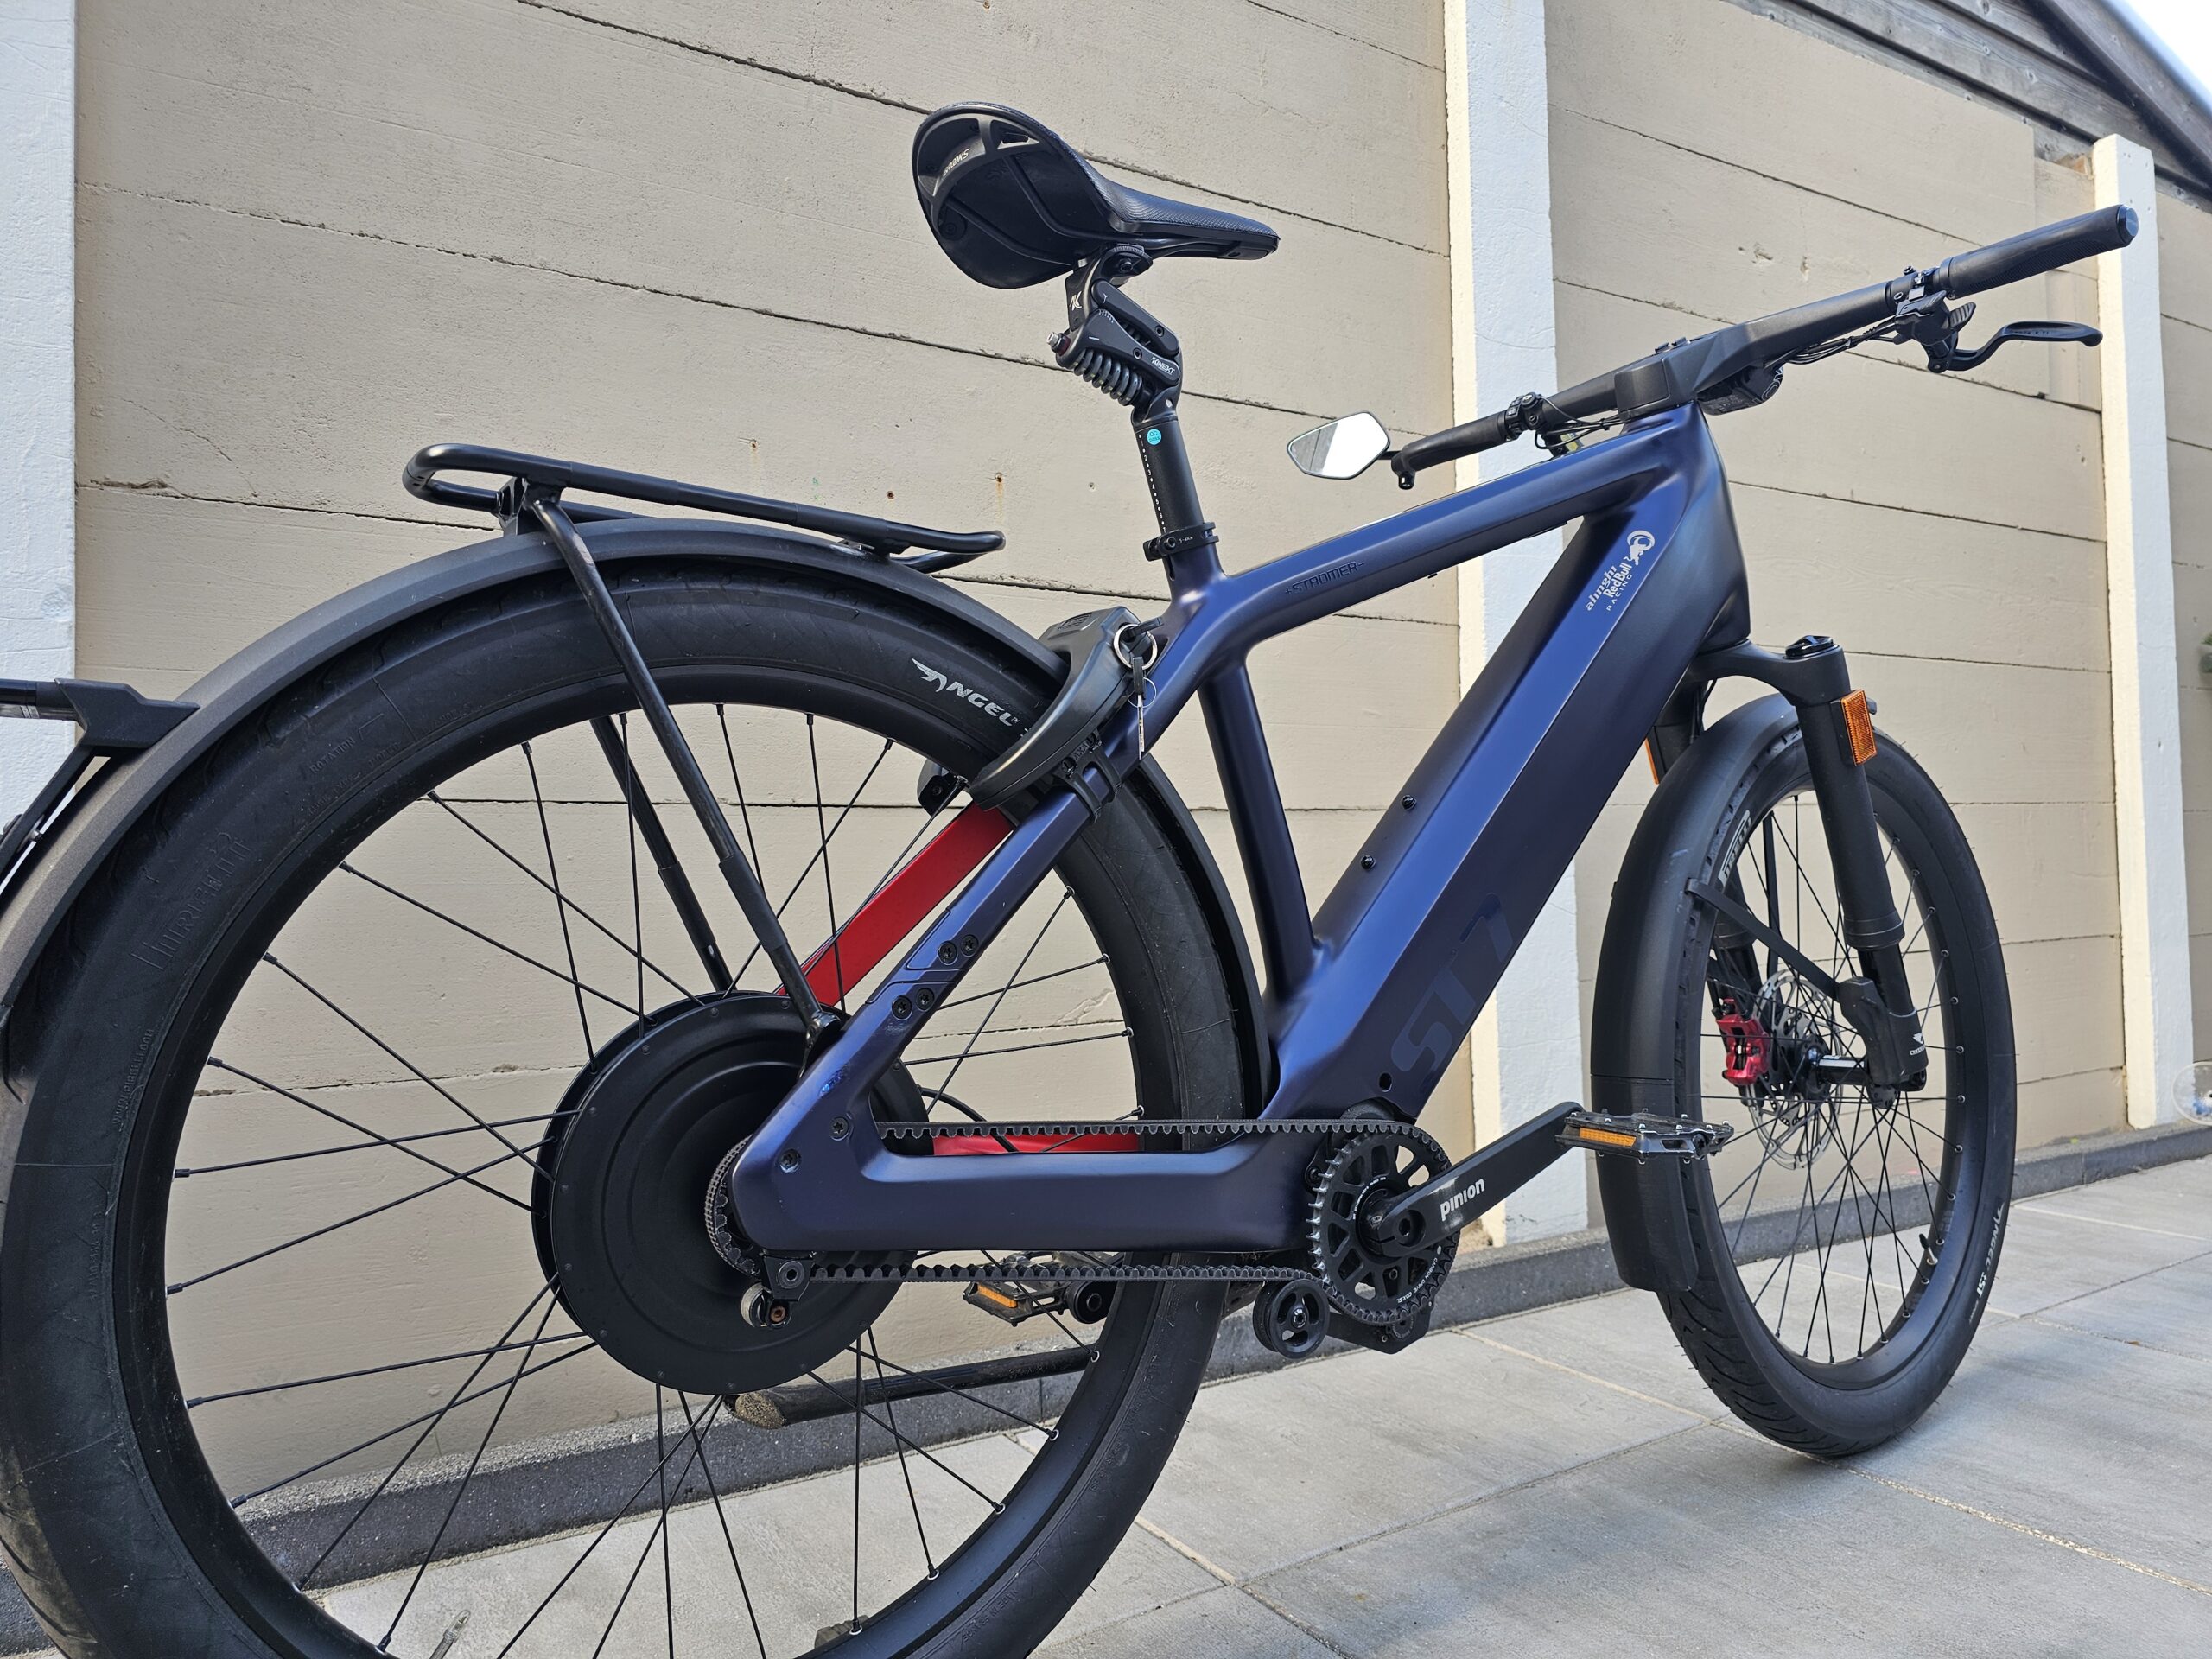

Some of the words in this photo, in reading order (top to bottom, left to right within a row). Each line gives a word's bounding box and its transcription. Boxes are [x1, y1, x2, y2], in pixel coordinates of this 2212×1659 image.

[1605, 574, 1633, 612] RACING
[308, 735, 356, 776] ROTATION
[1440, 1178, 1485, 1222] pinion
[1413, 1279, 1426, 1294] DRIVE
[1425, 1257, 1438, 1280] CARBON
